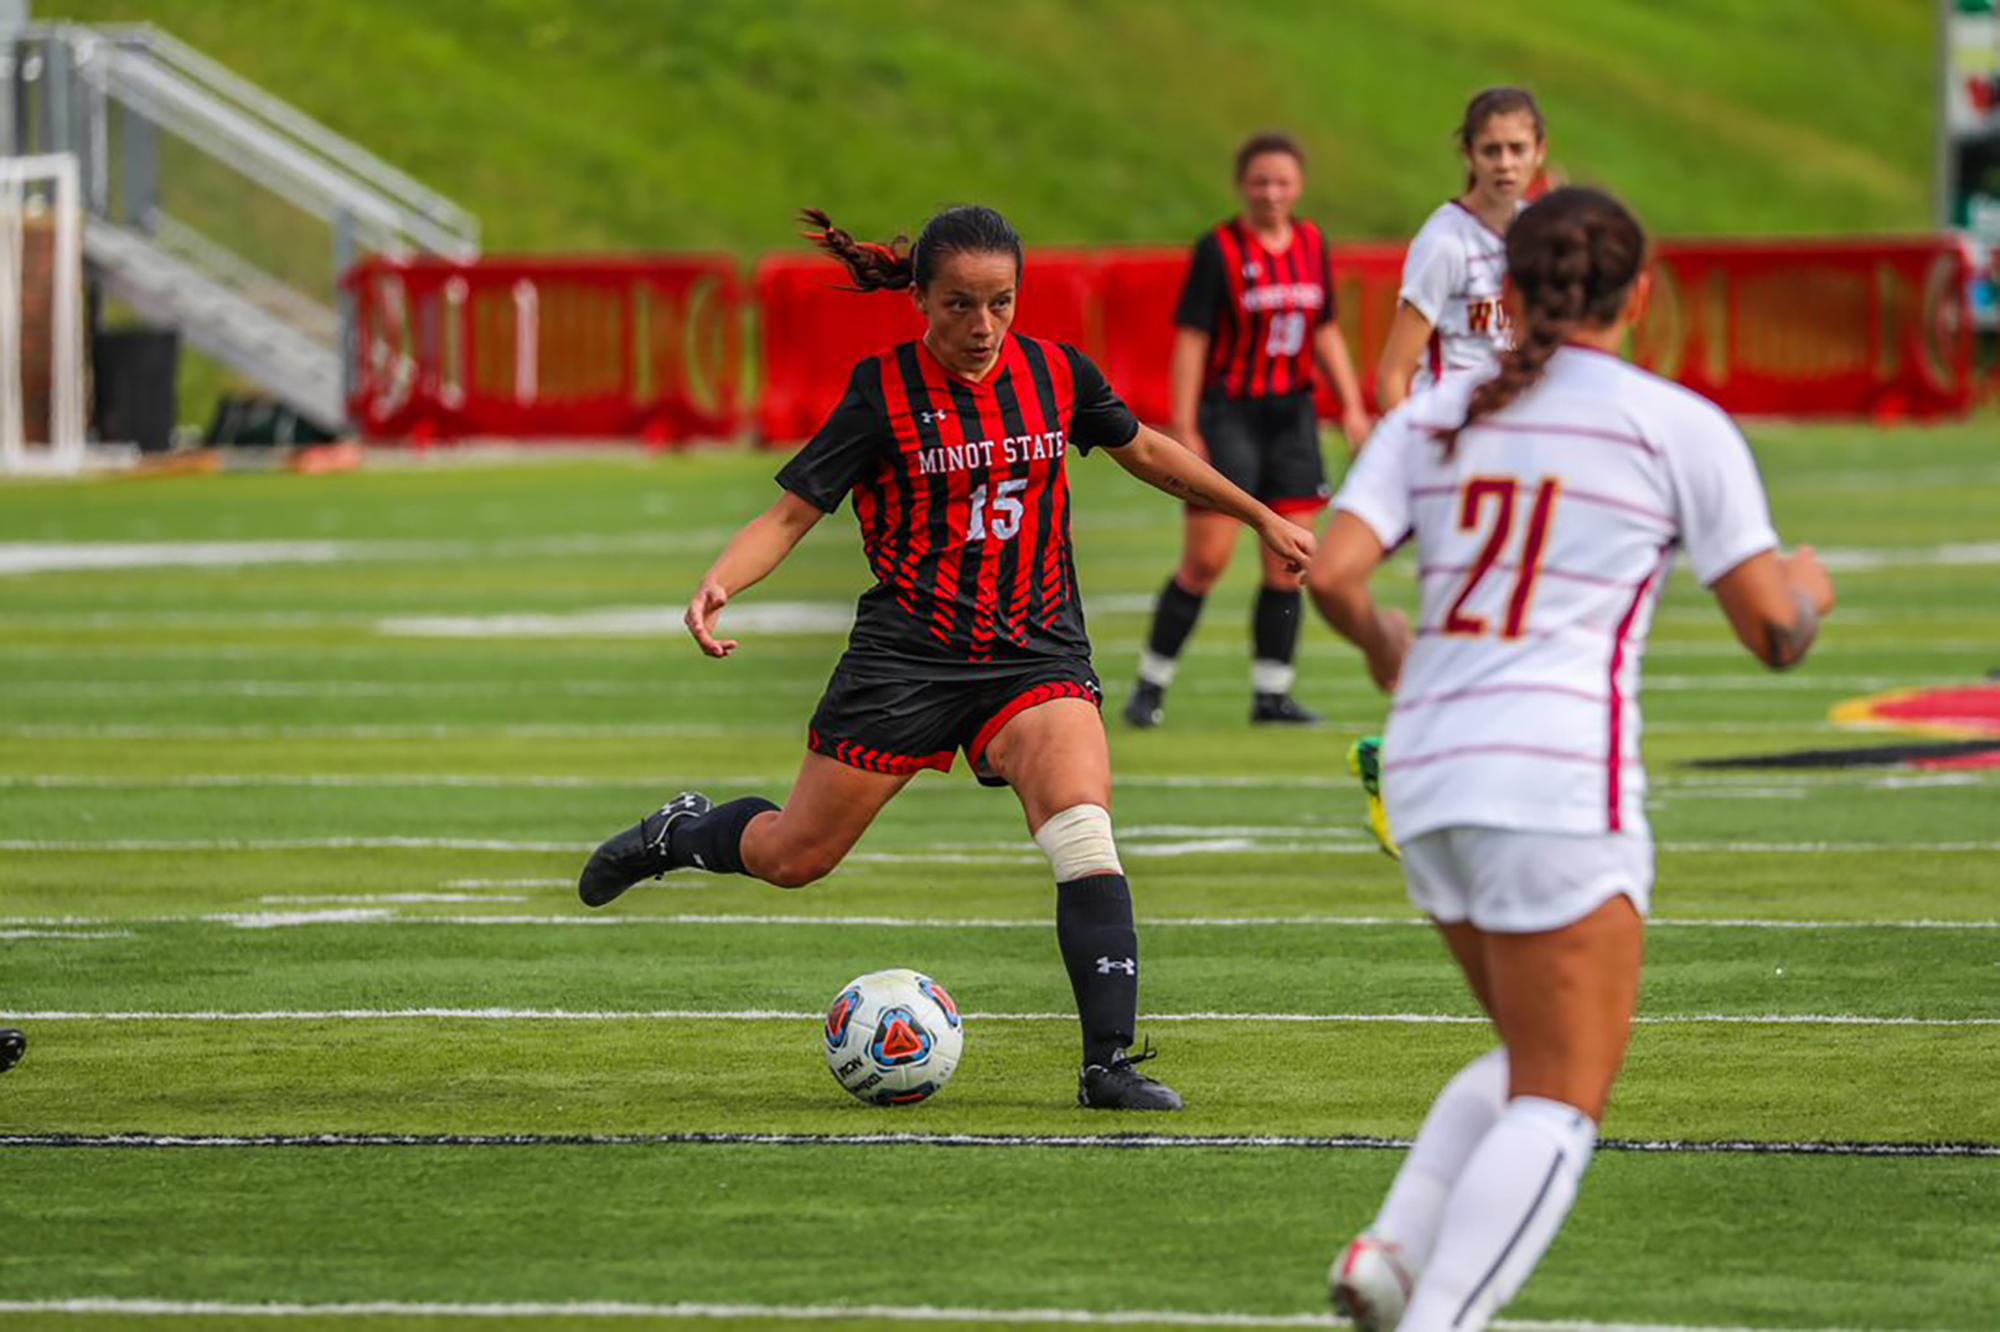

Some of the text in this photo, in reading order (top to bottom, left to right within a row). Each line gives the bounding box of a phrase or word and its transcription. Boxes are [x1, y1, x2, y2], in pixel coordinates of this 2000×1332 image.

[918, 431, 1064, 475] MINOT STATE
[965, 478, 1029, 542] 15
[1442, 475, 1562, 641] 21
